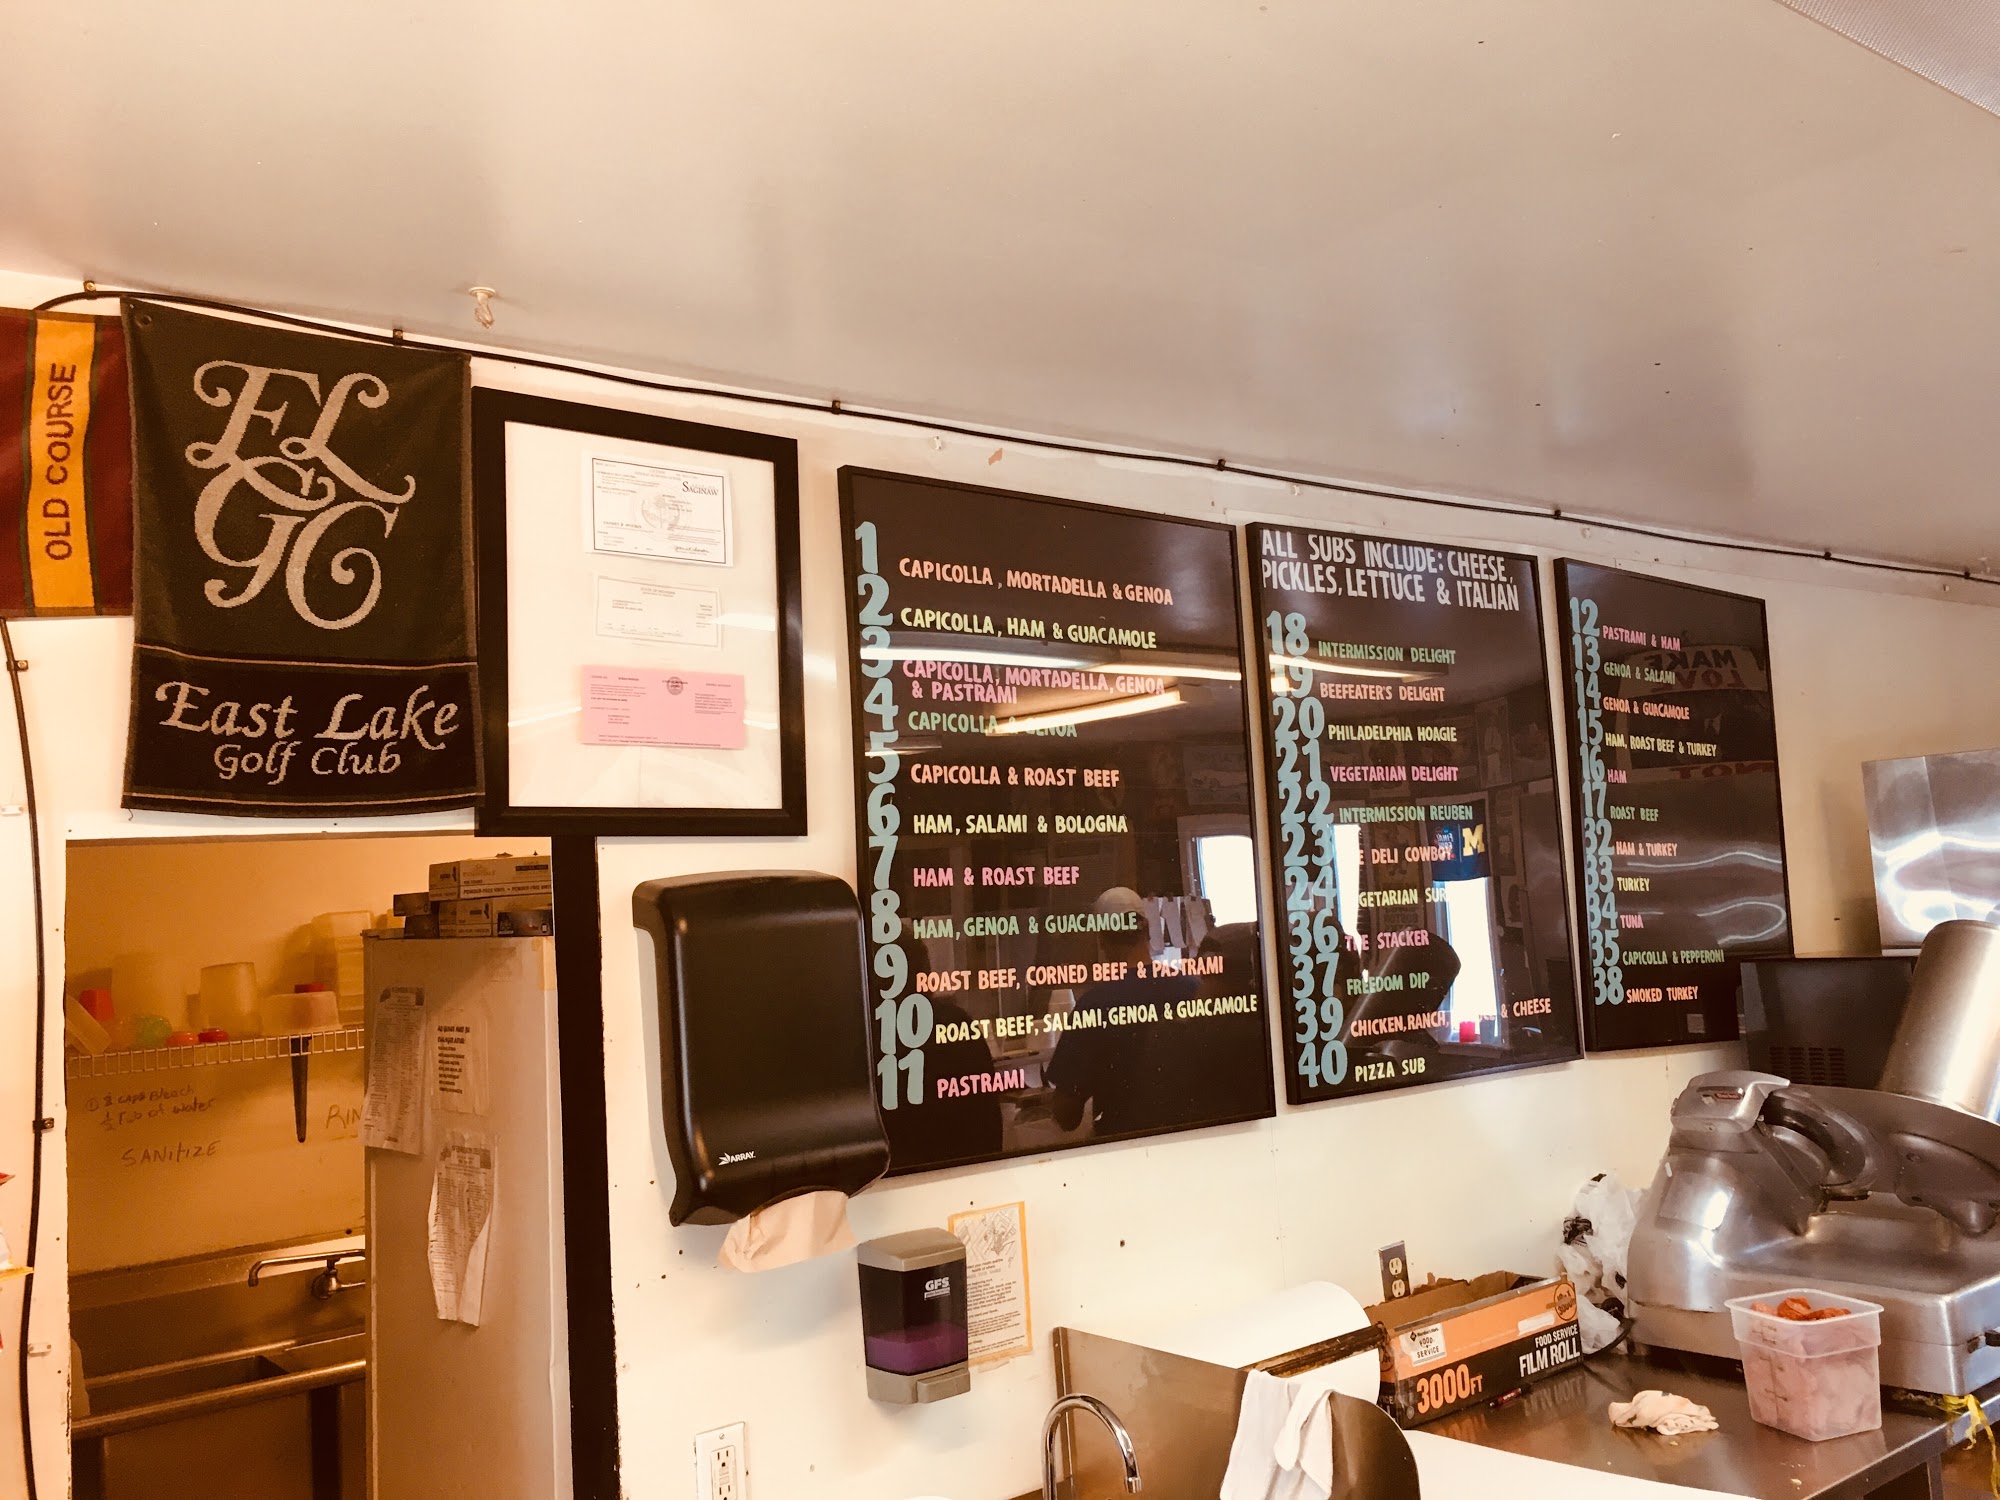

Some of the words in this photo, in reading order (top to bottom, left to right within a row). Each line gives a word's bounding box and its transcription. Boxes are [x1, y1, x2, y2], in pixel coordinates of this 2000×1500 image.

[46, 362, 77, 486] COURSE
[45, 498, 72, 562] OLD
[855, 521, 878, 574] 1
[1007, 570, 1107, 599] MORTADELLA
[1113, 584, 1123, 600] &
[1125, 584, 1174, 606] GENOA
[1261, 529, 1298, 559] ALL
[1308, 533, 1357, 564] SUBS
[1363, 540, 1445, 574] INCLUDE:
[1447, 550, 1514, 584] CHEESE,
[1262, 558, 1342, 596] PICKLES,
[1345, 568, 1426, 603] LETTUCE
[1436, 577, 1452, 605] &
[1456, 580, 1520, 611] ITALIAN
[857, 573, 893, 626] 2
[1007, 618, 1045, 639] HAM
[1053, 622, 1063, 640] &
[1067, 624, 1157, 649] GUACAMOLE
[1570, 597, 1600, 638] 12
[1603, 625, 1646, 646] PASTRAMI
[1661, 635, 1681, 651] HAM
[861, 626, 893, 678] 3
[1115, 675, 1165, 696] GENOA
[1266, 610, 1310, 656] 18
[1318, 640, 1404, 662] INTERMISSION
[1410, 646, 1456, 665] DELIGHT
[1572, 633, 1601, 673] 13
[1604, 661, 1631, 679] GENOA
[1644, 668, 1676, 685] SALAMI
[155, 680, 298, 740] East
[314, 684, 461, 752] Lake
[863, 678, 899, 731] 4
[908, 711, 998, 735] CAPICOLLA
[911, 681, 923, 700] &
[932, 682, 1018, 705] PASTRAMI
[1399, 685, 1445, 702] DELIGHT
[1575, 670, 1601, 710] 14
[1603, 696, 1631, 714] GENOA
[1642, 701, 1690, 720] GUACAMOLE
[1272, 696, 1325, 741] 20
[1328, 724, 1413, 741] PHILADELPHIA
[1417, 726, 1457, 742] HOAGIE
[1577, 705, 1604, 746] 15
[1630, 735, 1655, 751] ROAST
[1656, 737, 1675, 754] BEEF
[1686, 741, 1717, 757] TURKEY
[213, 740, 303, 786] Golf
[311, 741, 401, 776] Club
[867, 730, 900, 784] 5
[910, 763, 1001, 786] CAPICOLLA
[1008, 766, 1018, 785] &
[1024, 767, 1076, 787] ROAST
[1083, 769, 1120, 788] BEEF
[1275, 738, 1322, 783] 21
[1330, 765, 1407, 782] VEGETARIAN
[1411, 766, 1459, 782] DELIGHT
[1580, 742, 1605, 782] 16
[1607, 768, 1627, 784] HAM
[867, 783, 900, 836] 6
[913, 815, 960, 836] HAM,
[965, 814, 1028, 834] SALAMI
[1037, 815, 1048, 833] &
[1055, 814, 1128, 834] BOLOGNA
[1278, 780, 1334, 825] 22
[1339, 806, 1425, 824] INTERMISSION
[1430, 805, 1473, 820] REUBEN
[1582, 779, 1607, 819] 17
[1610, 805, 1636, 821] ROAST
[1640, 807, 1659, 822] BEEF
[1281, 822, 1335, 867] 23
[1372, 848, 1398, 865] DELI
[1405, 845, 1452, 862] COWBOY
[1583, 817, 1615, 856] 32
[1616, 841, 1635, 856] HAM
[1646, 842, 1678, 857] TURKEY
[868, 835, 899, 890] 7
[913, 868, 954, 887] HAM
[963, 868, 975, 886] &
[982, 866, 1035, 886] ROAST
[1043, 866, 1080, 885] BEEF
[1585, 853, 1614, 893] 33
[1617, 877, 1650, 892] TURKEY
[1284, 865, 1337, 912] 24
[1359, 888, 1418, 908] GETARIAN
[1587, 891, 1618, 930] 34
[1620, 914, 1644, 929] TUNA
[870, 890, 901, 944] 8
[963, 916, 1020, 937] GENOA
[1028, 916, 1039, 934] &
[1045, 912, 1138, 934] GUACAMOLE
[1288, 909, 1339, 955] 36
[1377, 930, 1429, 949] STACKER
[873, 943, 908, 1000] 9
[916, 970, 971, 993] ROAST
[978, 968, 1021, 990] BEEF,
[1026, 963, 1088, 986] CORNED
[1093, 961, 1128, 982] BEEF
[1136, 961, 1147, 979] &
[1152, 955, 1224, 978] PASTRAMI
[1590, 928, 1620, 968] 35
[1622, 950, 1668, 966] CAPICOLLA
[1680, 949, 1725, 964] PEPPERONI
[1291, 952, 1339, 999] 37
[1347, 975, 1403, 995] FREEDOM
[1409, 972, 1429, 989] DIP
[1593, 965, 1625, 1006] 38
[1626, 987, 1662, 1004] SMOKED
[1666, 985, 1699, 1001] TURKEY
[875, 993, 934, 1055] 10
[935, 1019, 989, 1044] ROAST
[996, 1015, 1039, 1037] BEEF,
[1108, 1002, 1158, 1025] GENOA
[1164, 1002, 1173, 1020] &
[1176, 994, 1258, 1019] GUACAMOLE
[1294, 997, 1344, 1043] 39
[1500, 1003, 1508, 1019] &
[1513, 997, 1552, 1017] CHEESE
[877, 1049, 925, 1110] 11
[937, 1069, 1026, 1099] PASTRAMI
[1298, 1040, 1348, 1088] 40
[1355, 1062, 1395, 1082] PIZZA
[1402, 1057, 1426, 1076] SUB
[730, 1151, 756, 1164] ARRAY
[925, 1276, 951, 1291] GFS
[1417, 1346, 1440, 1358] SERVICE
[1519, 1348, 1549, 1377] FILM
[1550, 1337, 1580, 1366] ROLL
[1535, 1333, 1552, 1348] FOOD
[1552, 1324, 1578, 1342] SERVICE
